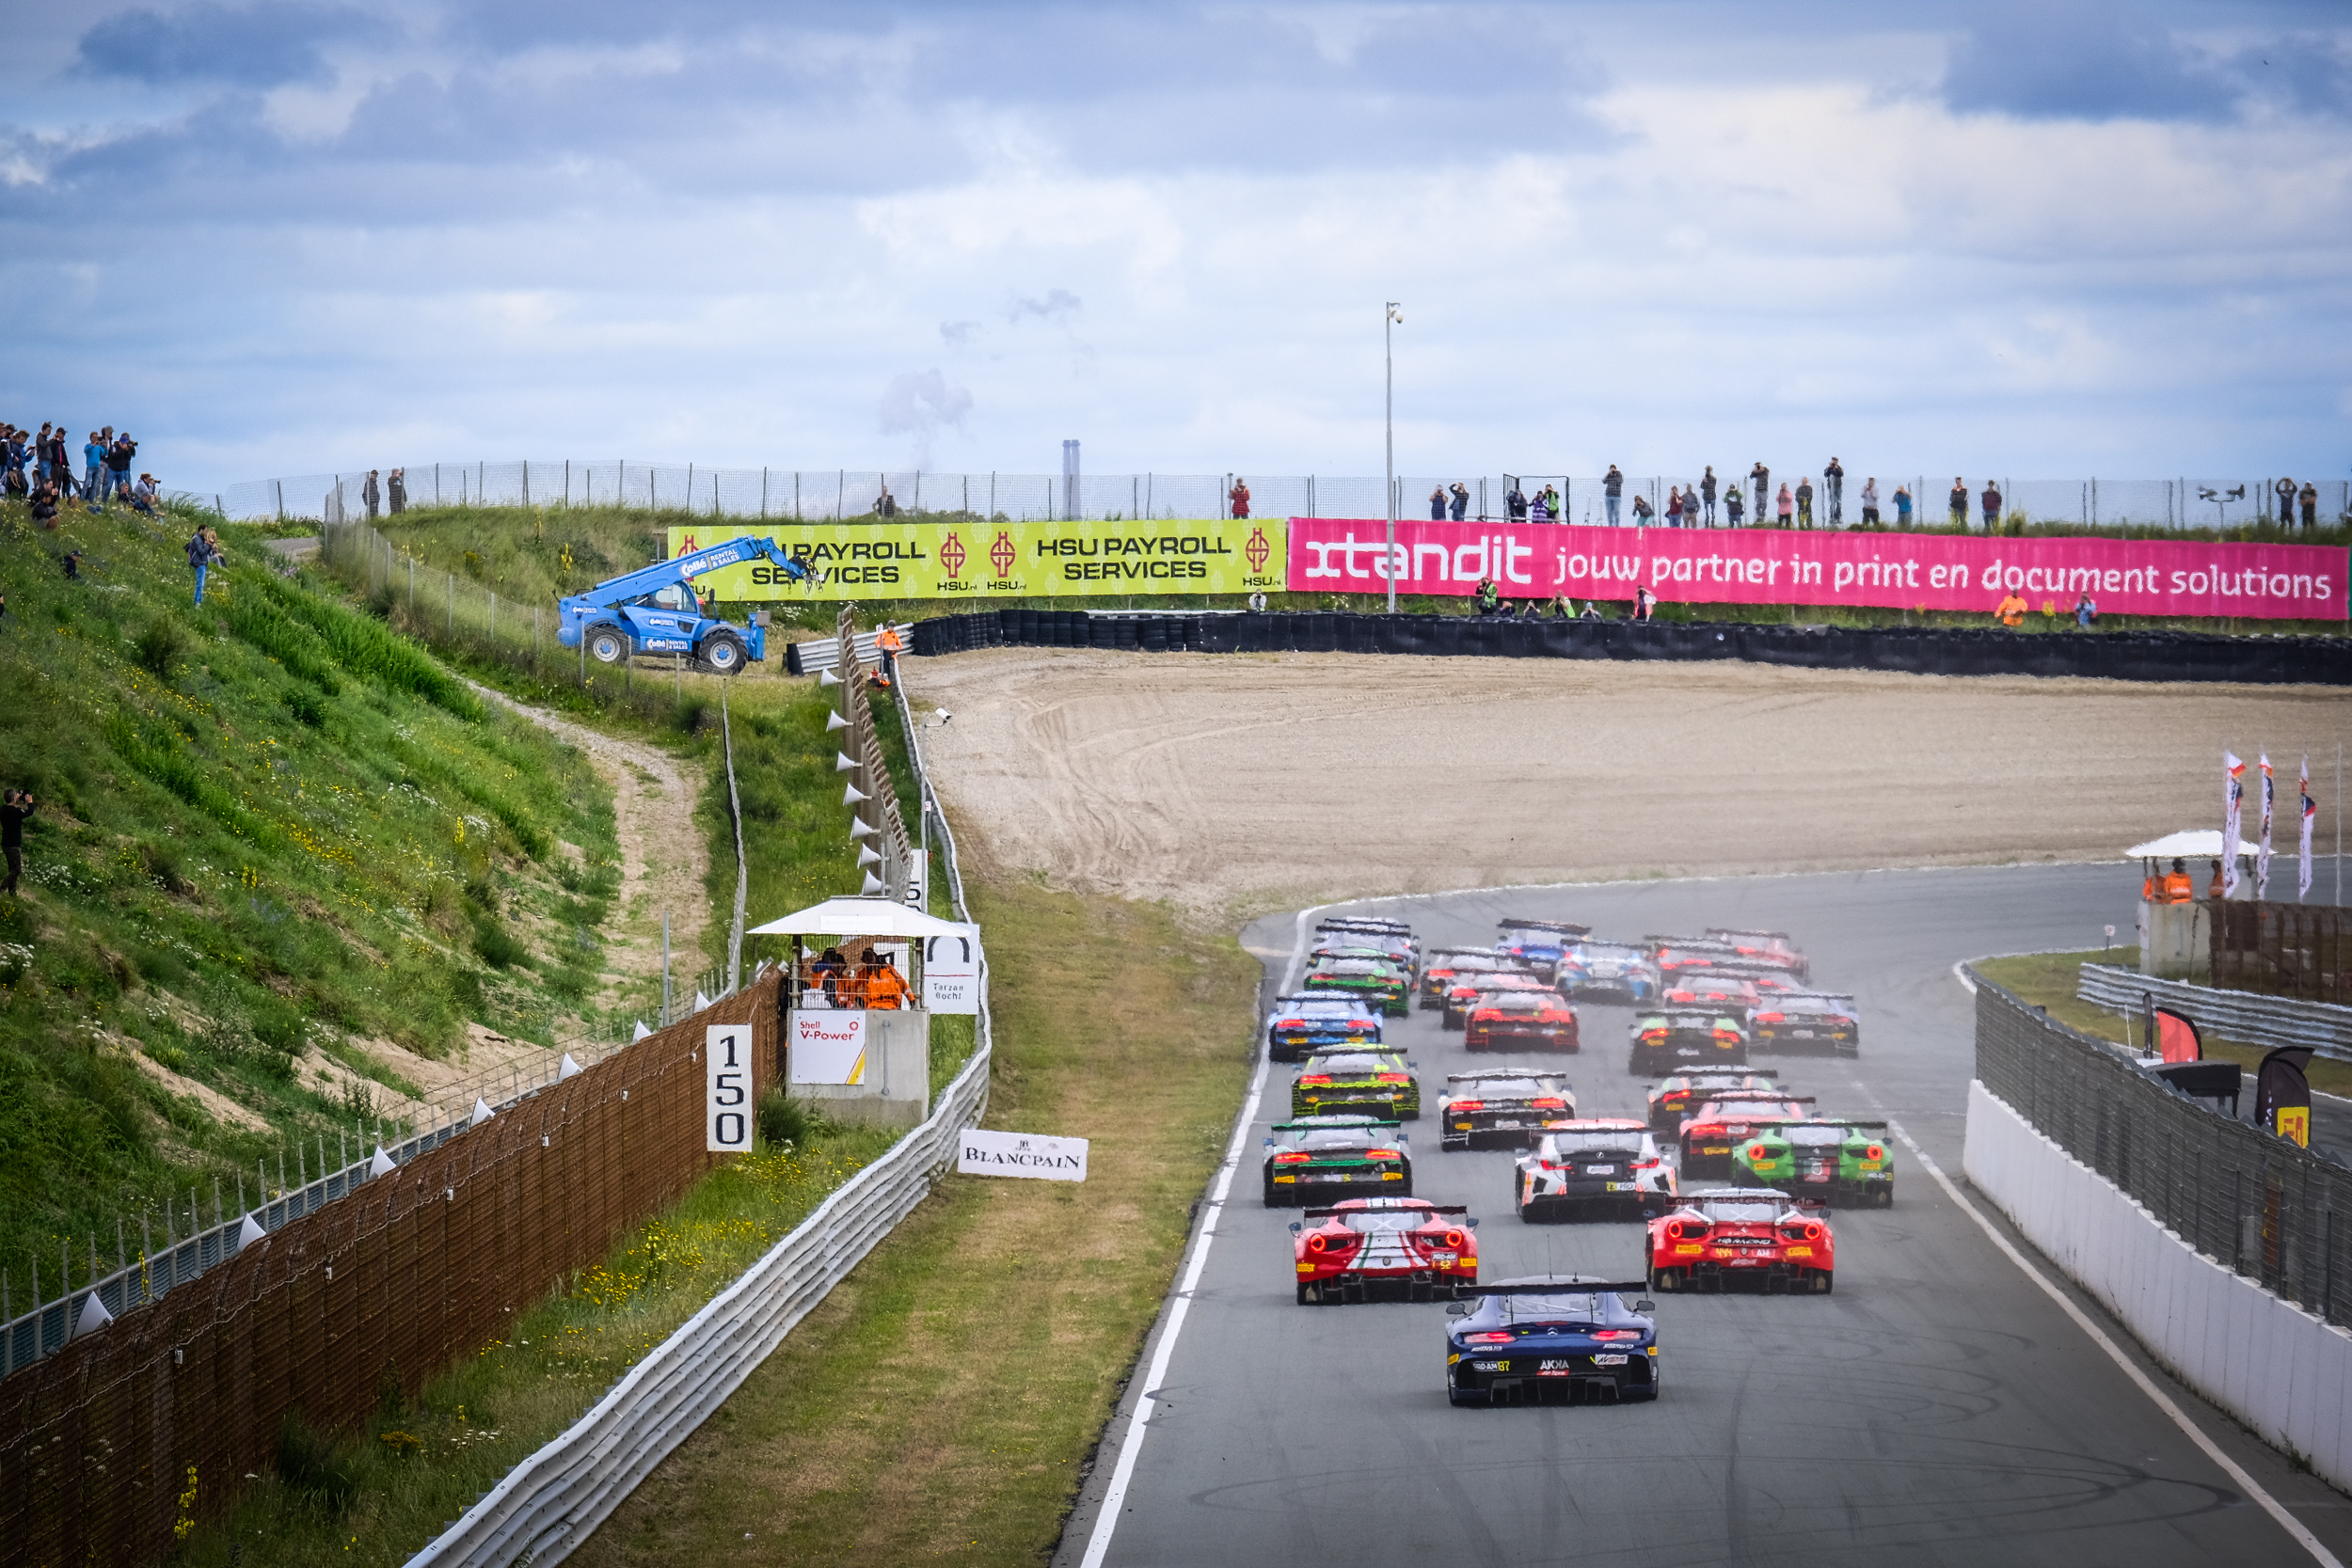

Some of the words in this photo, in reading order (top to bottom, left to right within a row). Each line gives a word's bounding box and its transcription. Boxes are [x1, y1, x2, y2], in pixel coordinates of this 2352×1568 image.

[793, 542, 927, 560] PAYROLL
[1038, 539, 1098, 556] HSU
[1104, 536, 1232, 555] PAYROLL
[710, 549, 738, 562] RENTAL
[719, 554, 740, 565] SALES
[1306, 532, 1533, 584] xtandit
[1064, 562, 1207, 580] SERVICES
[1553, 546, 1642, 586] jouw
[1651, 553, 1782, 587] partner
[1790, 553, 1822, 585] in
[1835, 554, 1920, 593] print
[1930, 562, 1969, 589] en
[1981, 559, 2160, 594] document
[2169, 564, 2332, 600] solutions
[800, 1030, 854, 1040] V-Power
[715, 1035, 745, 1145] 150
[965, 1147, 1081, 1169] BLANCPAIN
[1498, 1360, 1511, 1371] 87
